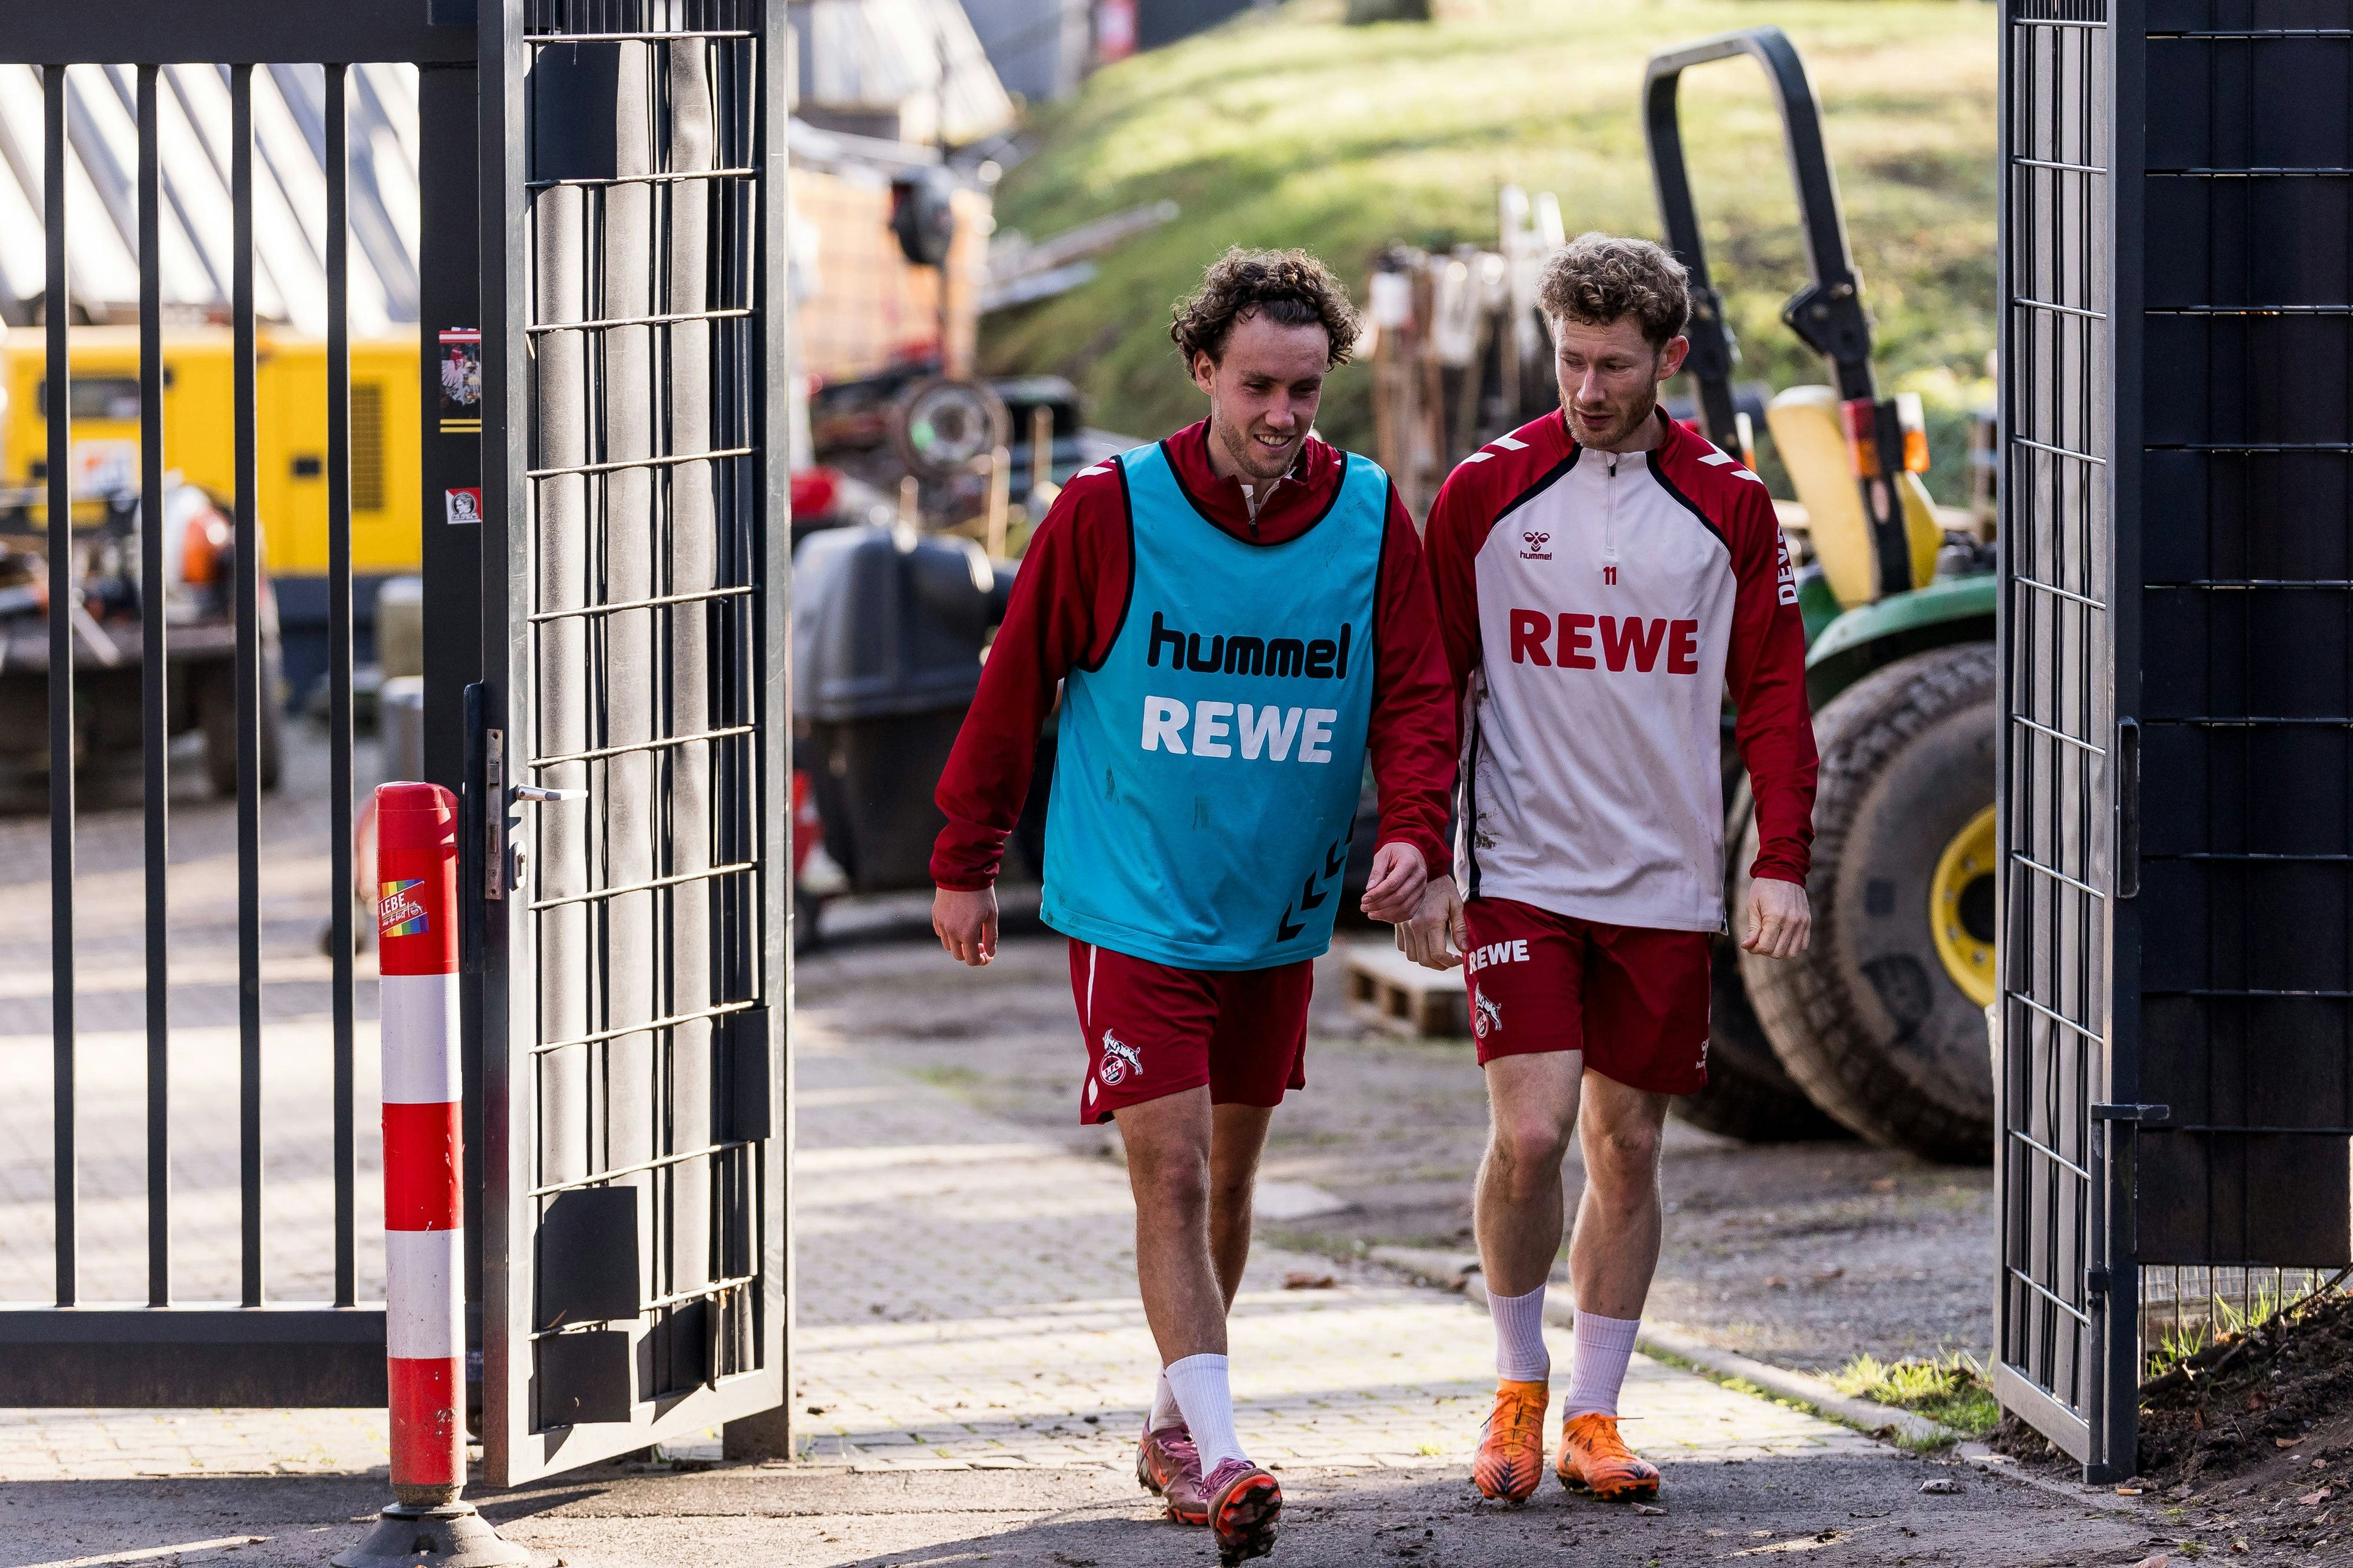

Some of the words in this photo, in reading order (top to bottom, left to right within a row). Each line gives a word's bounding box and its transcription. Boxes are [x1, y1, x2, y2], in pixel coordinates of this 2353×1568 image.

[1519, 550, 1552, 561] hummel
[1603, 566, 1617, 586] 11
[1146, 610, 1352, 680] hummel
[1509, 608, 1699, 675] REWE
[1141, 695, 1338, 763] REWE
[381, 892, 406, 917] LEBE
[1469, 939, 1530, 975] REWE
